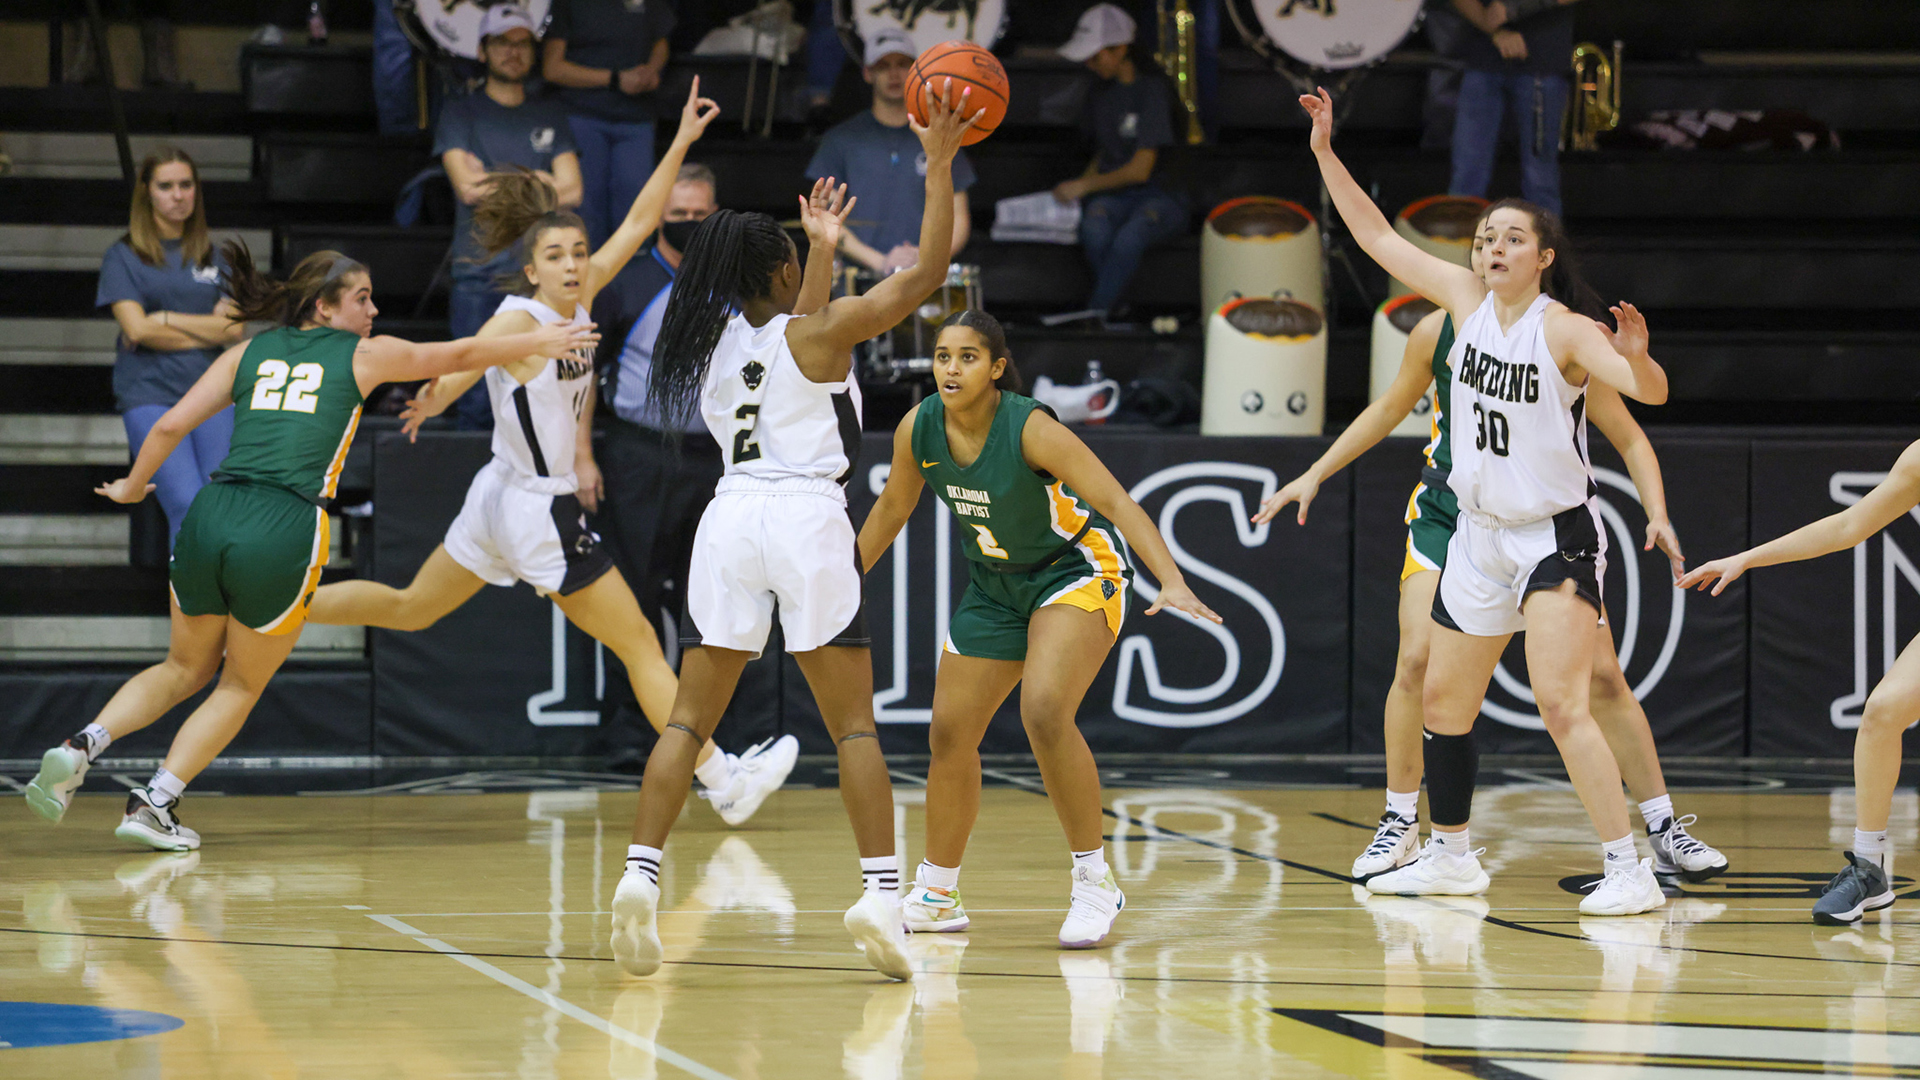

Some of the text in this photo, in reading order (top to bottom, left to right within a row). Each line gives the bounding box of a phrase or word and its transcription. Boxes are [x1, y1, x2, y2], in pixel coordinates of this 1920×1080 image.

[250, 359, 324, 414] 22
[1459, 343, 1539, 403] HARDING
[732, 404, 762, 465] 2
[1473, 402, 1510, 457] 30
[946, 484, 991, 504] OKLAHOMA
[954, 501, 990, 518] BAPTIST
[969, 523, 1009, 560] 2
